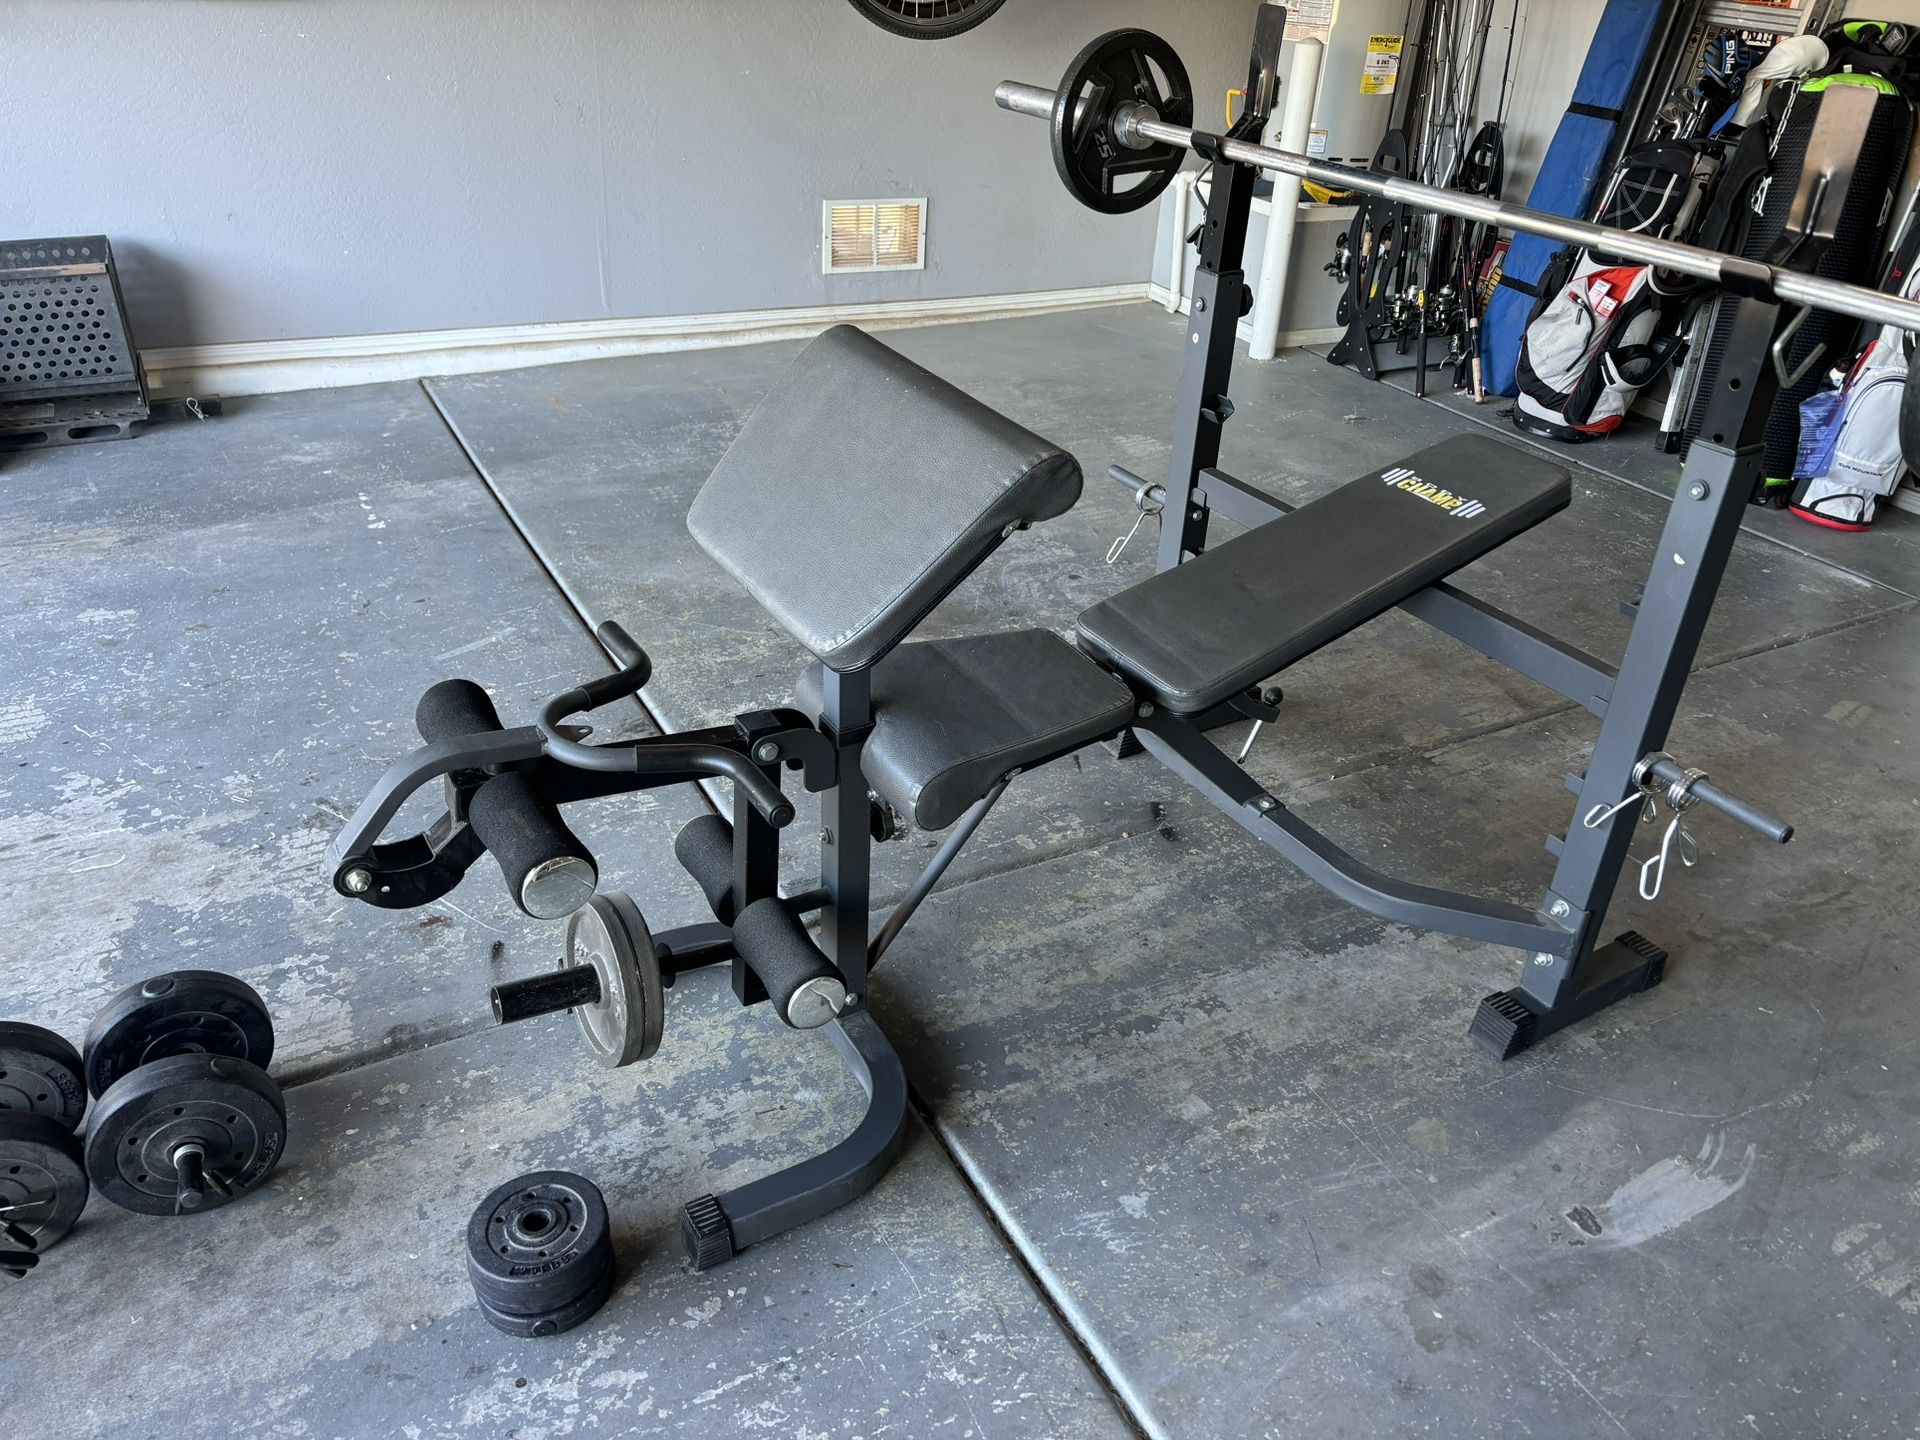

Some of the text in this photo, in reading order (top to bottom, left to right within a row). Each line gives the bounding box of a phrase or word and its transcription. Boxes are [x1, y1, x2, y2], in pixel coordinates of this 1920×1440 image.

[1725, 40, 1735, 74] PING
[1094, 131, 1113, 158] 25
[1852, 466, 1884, 477] MOUNTAIN
[1397, 478, 1463, 510] CHAMP
